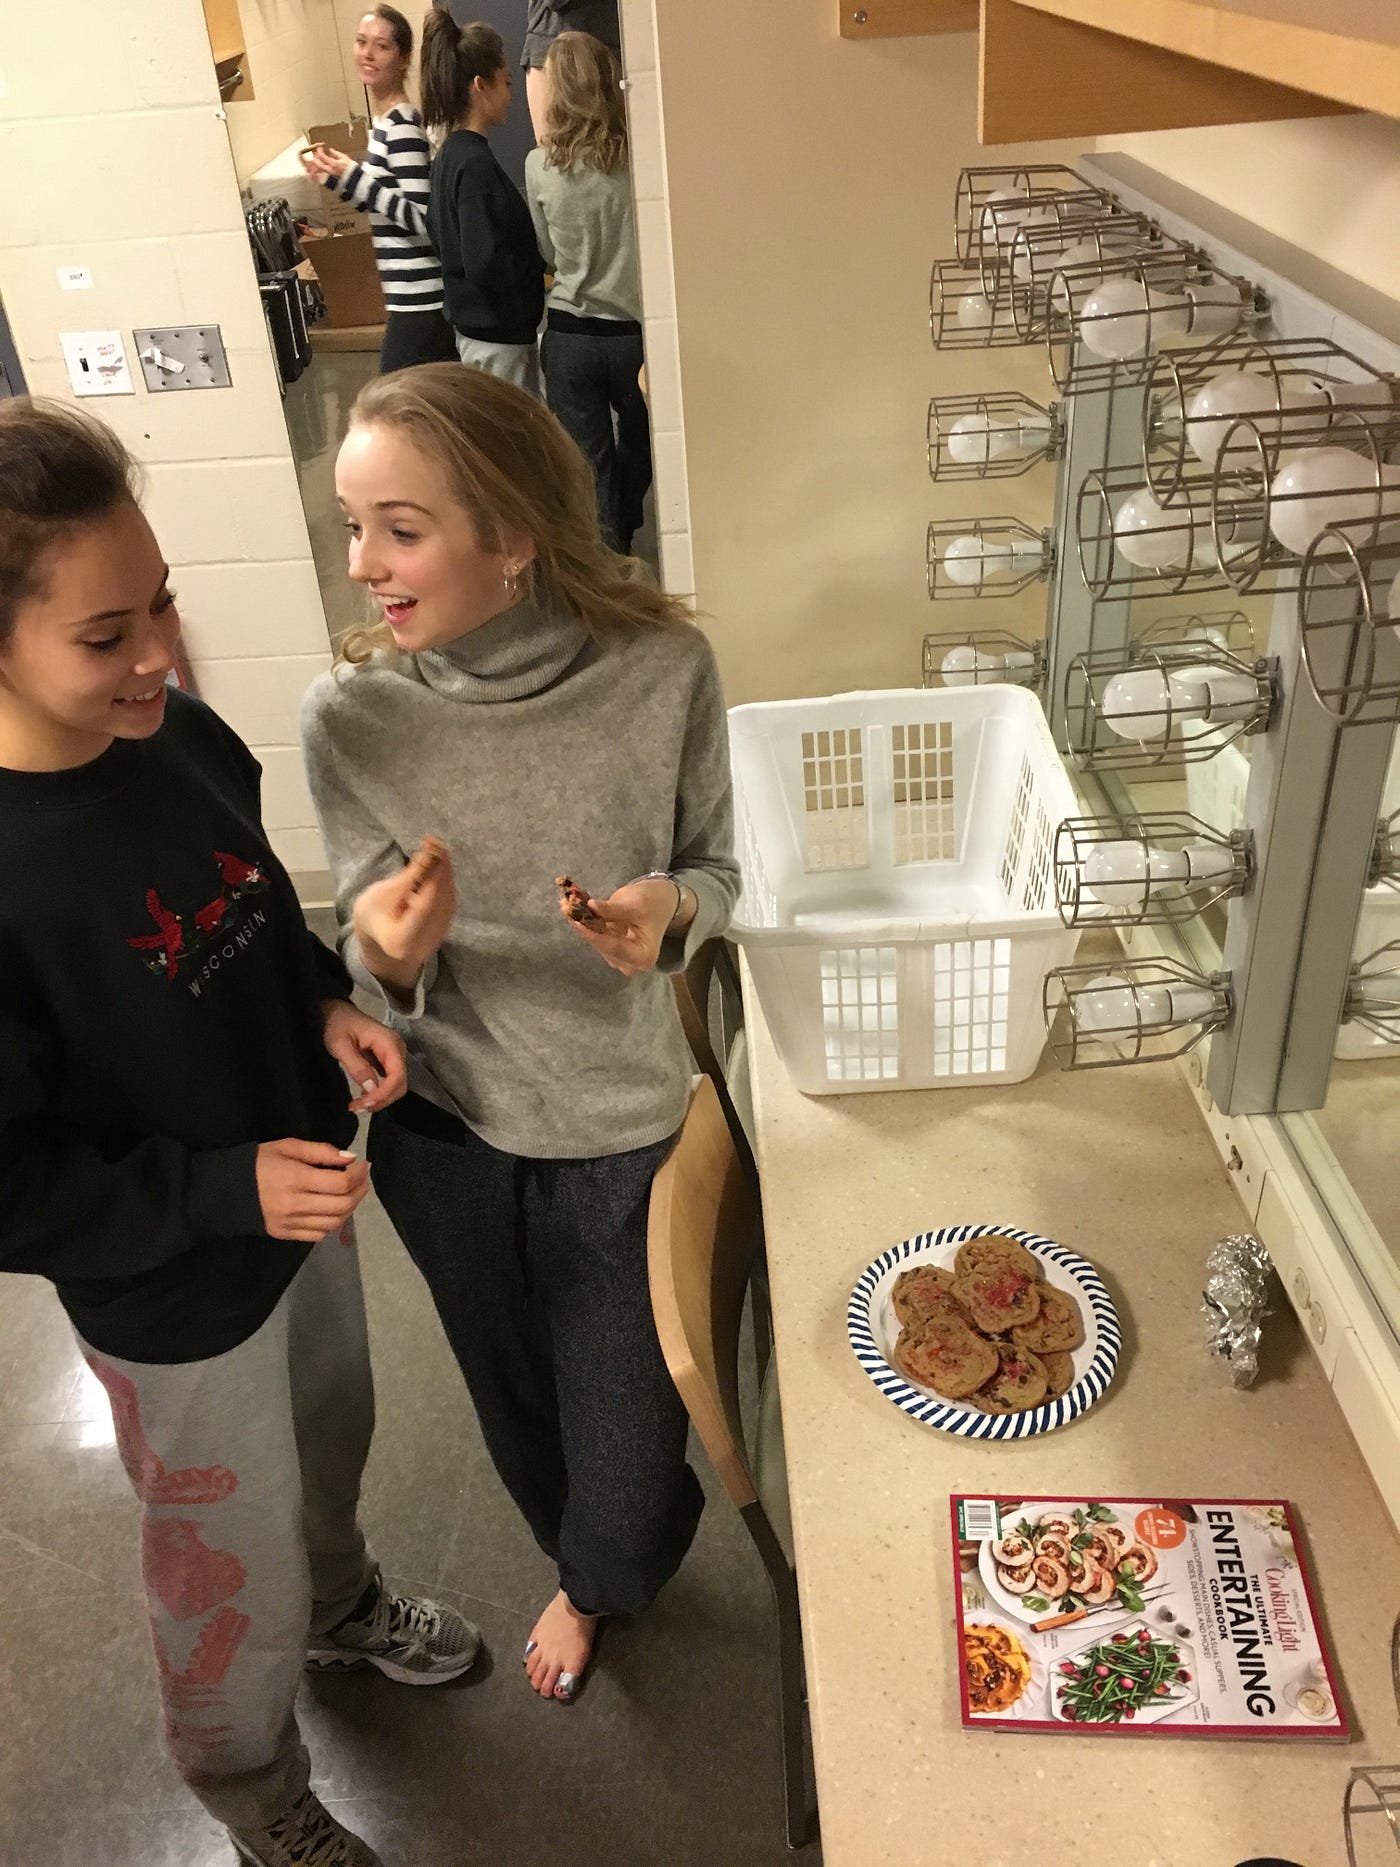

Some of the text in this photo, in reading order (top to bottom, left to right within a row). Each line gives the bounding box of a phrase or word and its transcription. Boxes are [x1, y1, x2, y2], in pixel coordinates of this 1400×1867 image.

[188, 909, 267, 998] WISCONSIN
[1189, 1529, 1204, 1582] SHOWSTOPPING
[1200, 1583, 1209, 1603] MAIN
[1208, 1630, 1218, 1659] CASUAL
[1197, 1618, 1206, 1634] AND
[1206, 1511, 1276, 1717] ENTERTAINING
[1209, 1579, 1228, 1640] COOKBOOK
[1250, 1575, 1273, 1646] THE ULTIMATE
[1264, 1568, 1301, 1652] Cooking Light
[1291, 1589, 1306, 1632] SPECIAL EDITION
[1201, 1635, 1210, 1659] MORE!
